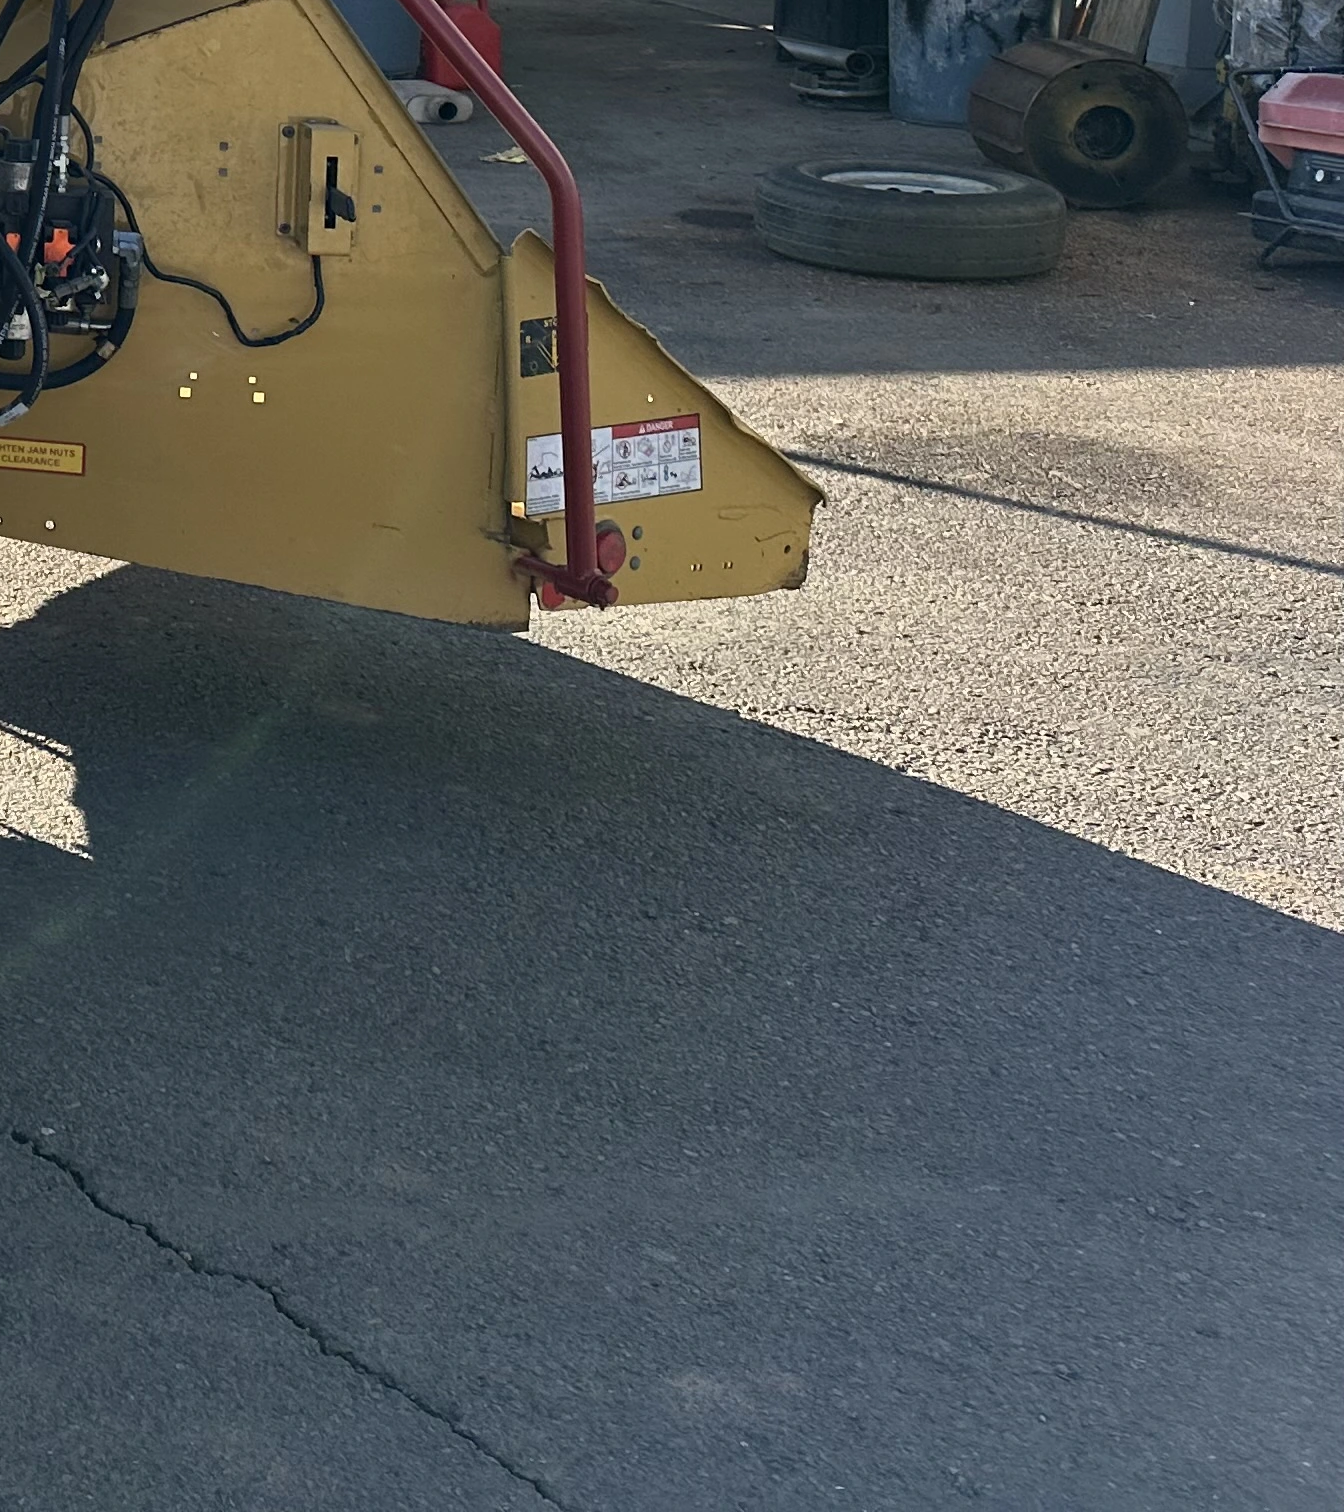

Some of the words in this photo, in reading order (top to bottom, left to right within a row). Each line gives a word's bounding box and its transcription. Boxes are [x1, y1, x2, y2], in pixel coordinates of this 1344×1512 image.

[646, 420, 674, 432] DANGER
[27, 446, 48, 455] JAM
[49, 448, 76, 458] NUTS
[1, 454, 61, 467] CLEARANCE
